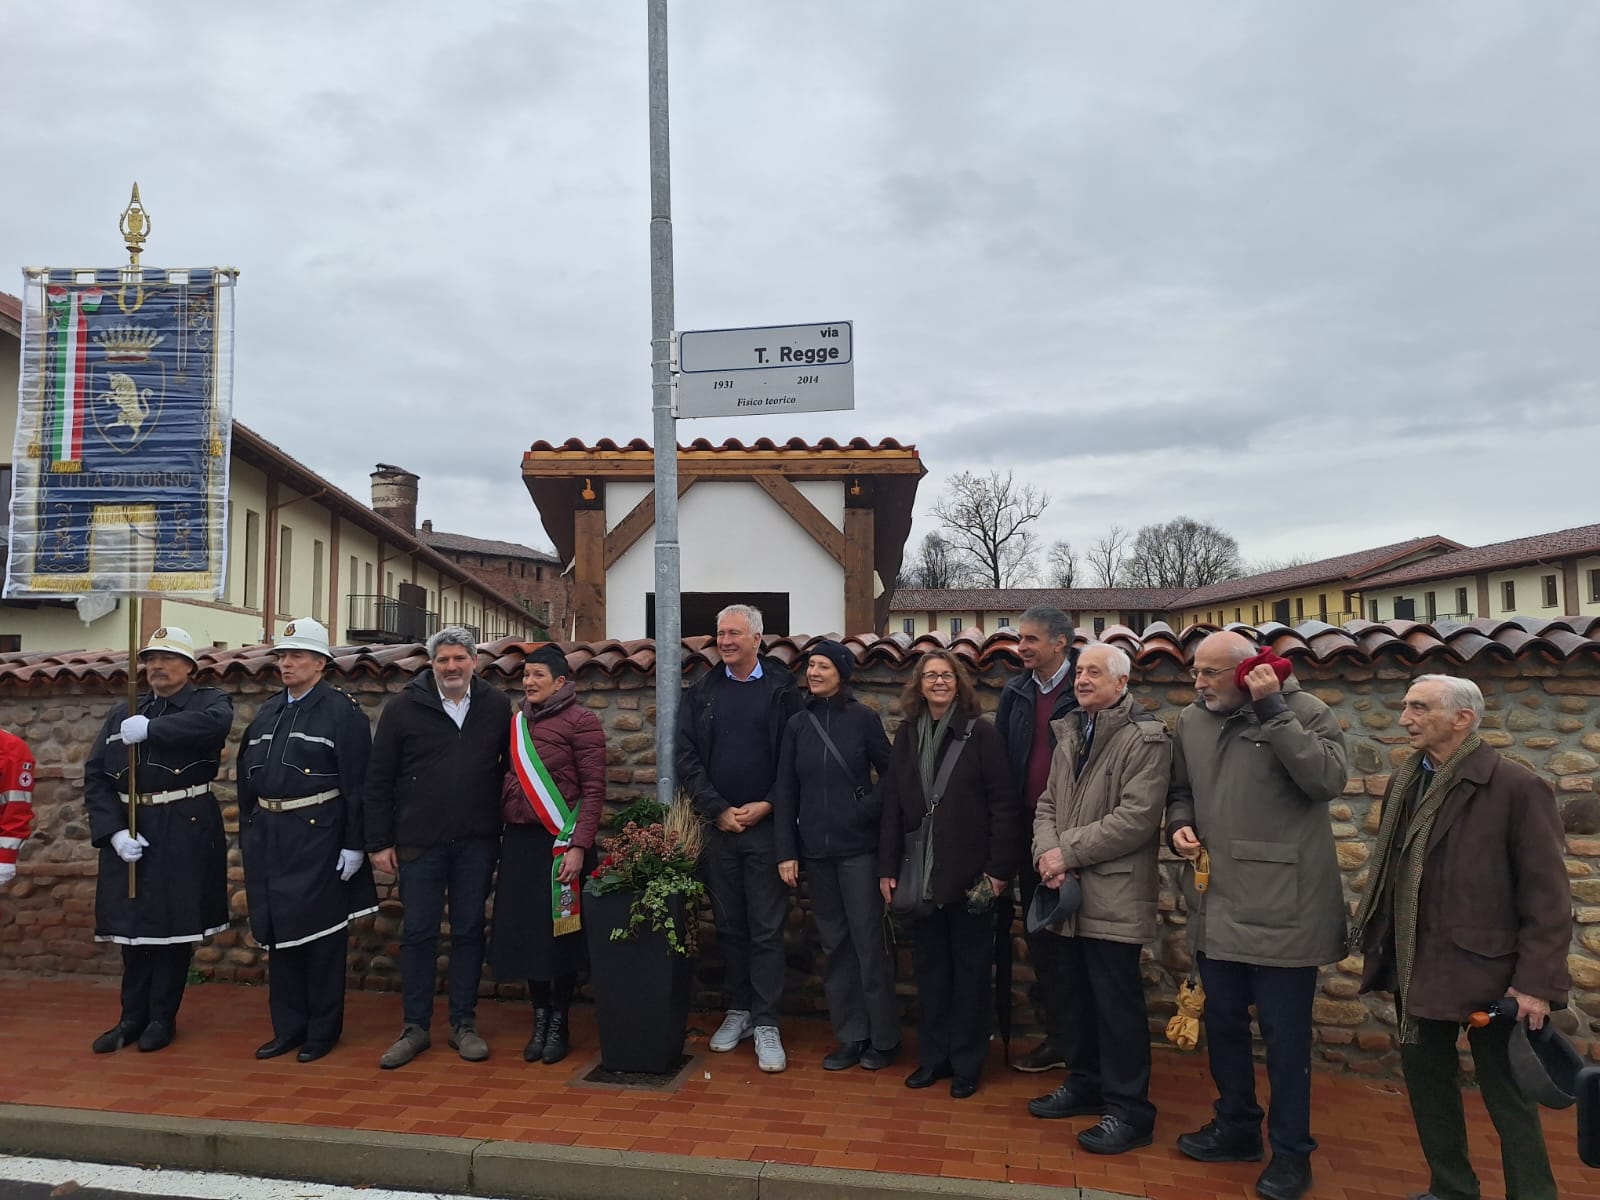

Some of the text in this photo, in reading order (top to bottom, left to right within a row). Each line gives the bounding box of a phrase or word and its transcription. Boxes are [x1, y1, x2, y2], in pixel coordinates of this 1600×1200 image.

[820, 327, 839, 338] via
[754, 346, 839, 363] T. Regge
[713, 380, 734, 389] 1931
[796, 375, 819, 384] 2014
[737, 396, 796, 406] Fisico teorico
